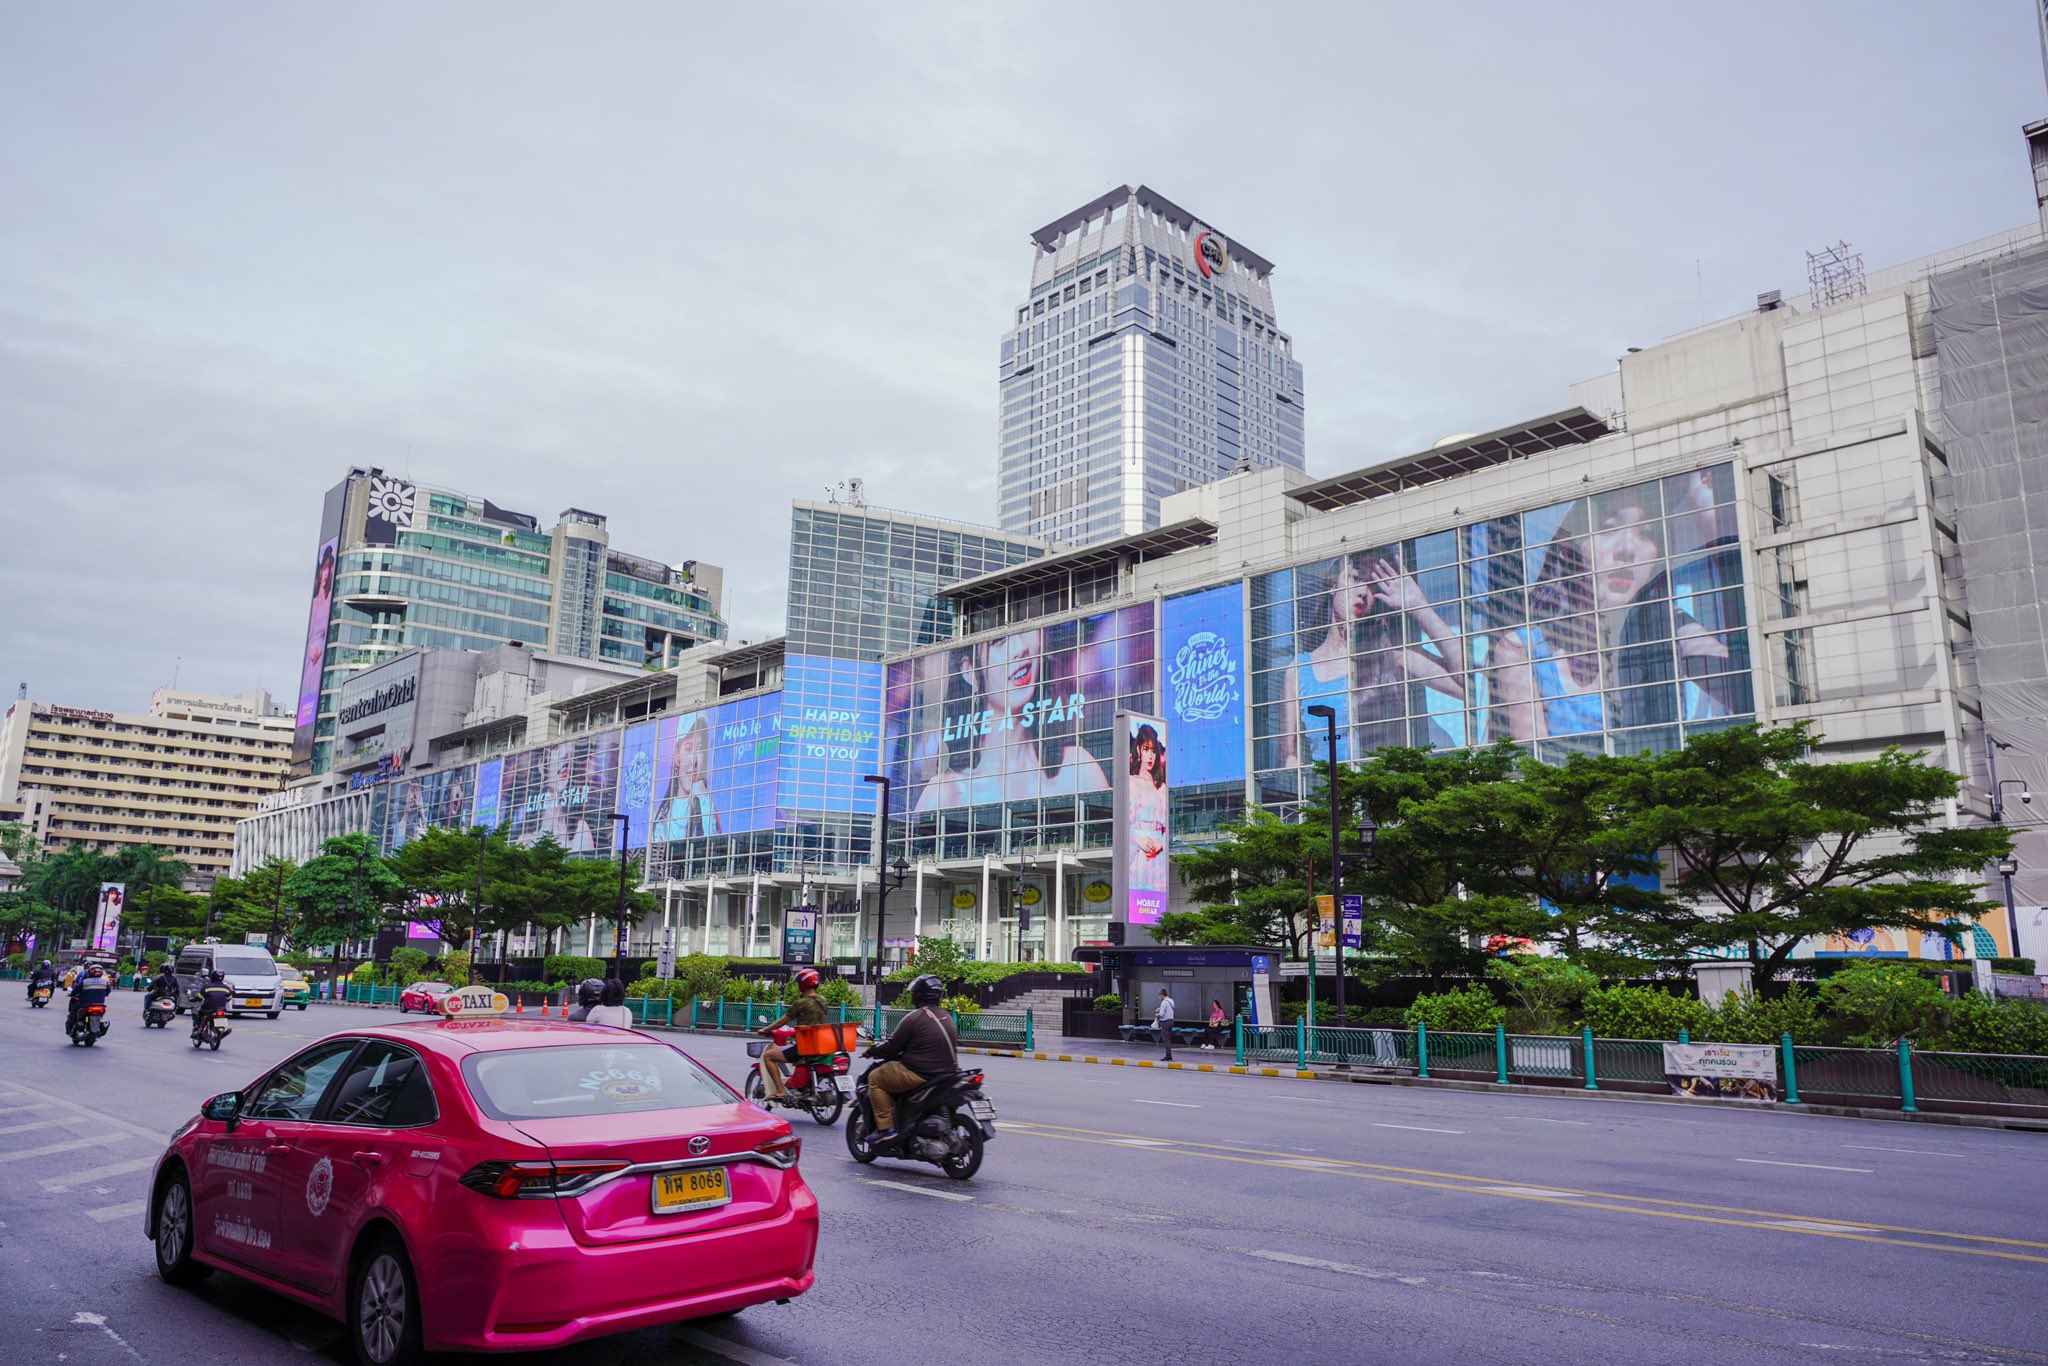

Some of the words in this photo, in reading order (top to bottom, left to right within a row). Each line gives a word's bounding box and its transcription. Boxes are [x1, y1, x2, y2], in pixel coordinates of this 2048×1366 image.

[1171, 640, 1229, 684] Shines
[1175, 680, 1231, 708] World
[805, 708, 861, 724] HAPPY
[943, 709, 994, 743] LIKE
[999, 710, 1014, 732] A
[1021, 693, 1085, 728] STAR
[723, 720, 761, 741] Moble
[789, 724, 874, 744] BIRTHDAY
[806, 745, 826, 757] TO
[829, 747, 859, 760] YOU
[526, 793, 549, 813] LIKE
[561, 785, 590, 807] STAR
[1137, 899, 1160, 908] MOBILE
[462, 994, 492, 1009] TAXI
[690, 1173, 722, 1191] 8069
